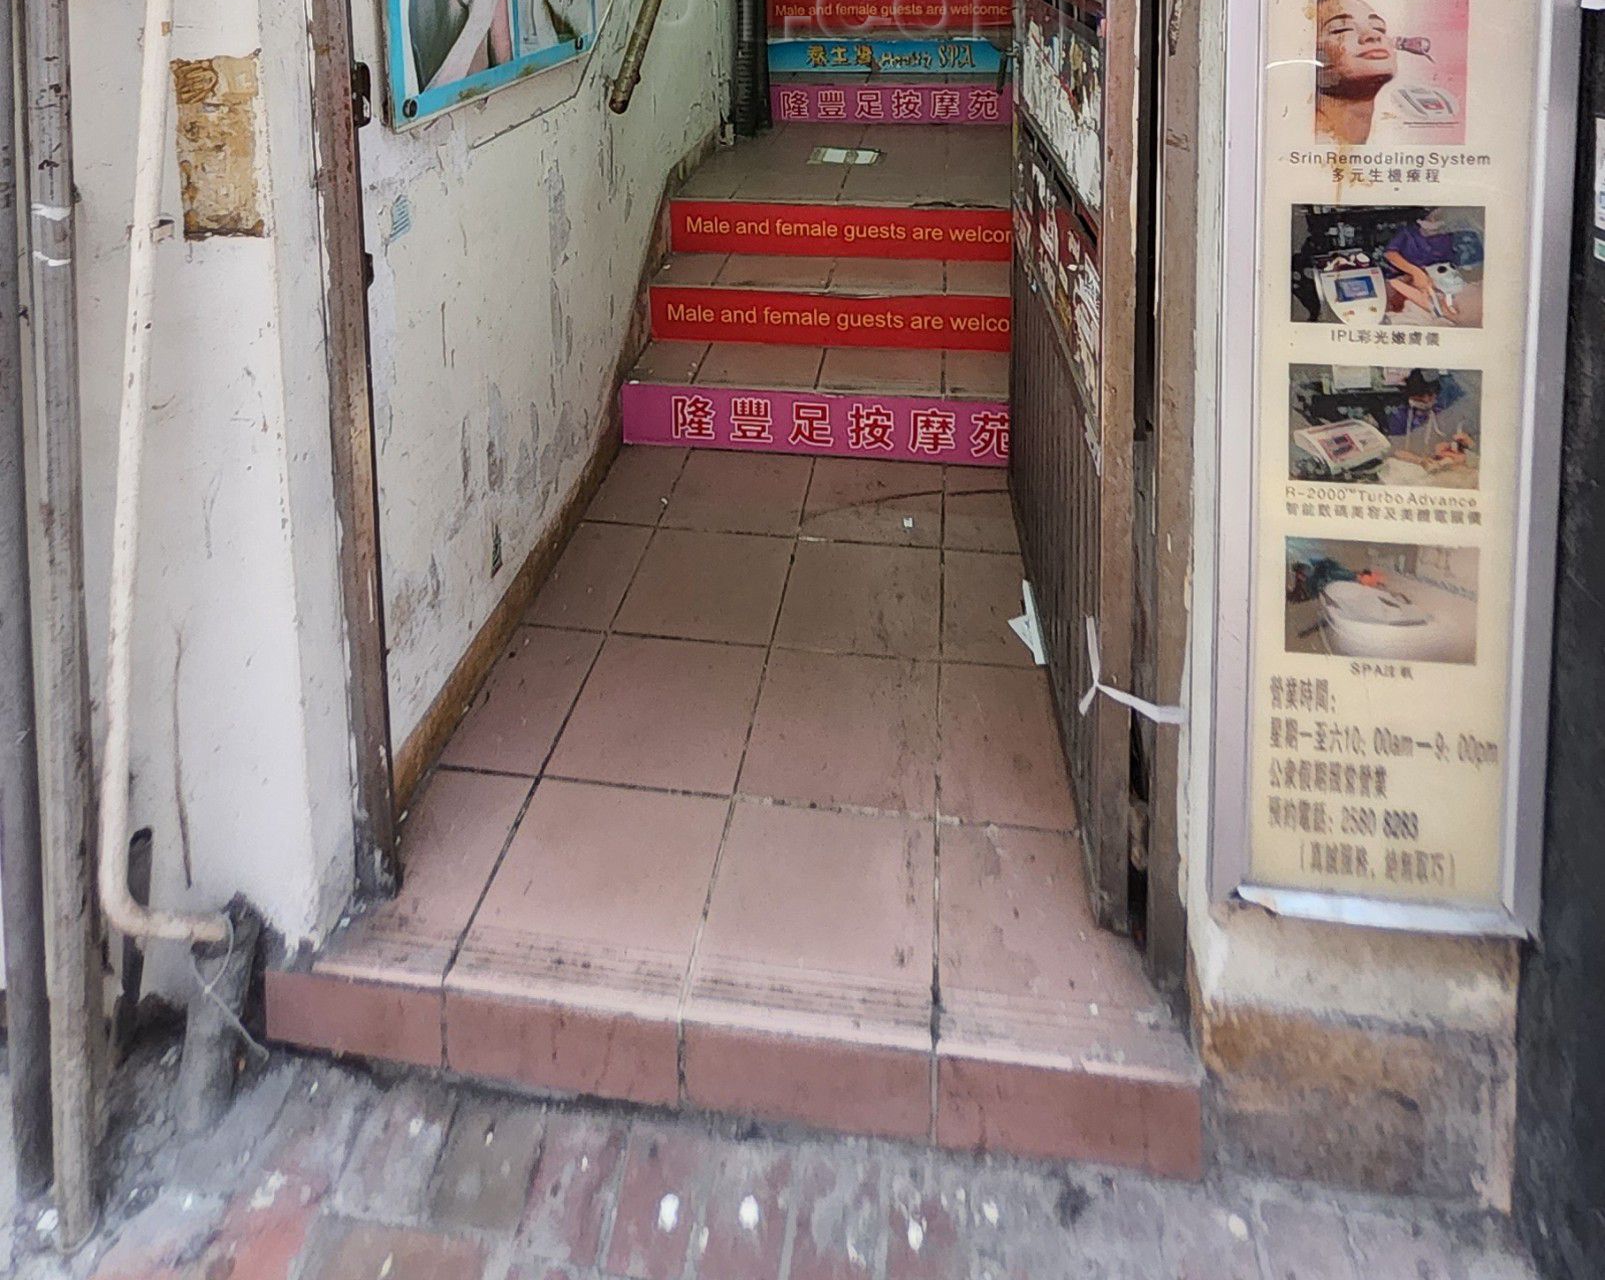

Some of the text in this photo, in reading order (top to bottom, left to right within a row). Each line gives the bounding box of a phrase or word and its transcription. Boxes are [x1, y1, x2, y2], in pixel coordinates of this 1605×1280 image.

[776, 4, 1008, 18] Male and female guests are welcome
[781, 90, 999, 120] 隆豐足按摩苑
[1326, 152, 1424, 167] Remodeling
[1428, 152, 1490, 168] System
[686, 217, 730, 234] Male
[736, 218, 770, 235] and
[776, 219, 838, 238] female
[844, 222, 906, 242] guests
[912, 227, 944, 242] are
[667, 304, 714, 323] Male
[720, 306, 757, 324] and
[764, 307, 830, 327] female
[836, 313, 904, 332] guests
[911, 316, 944, 331] are
[671, 395, 1010, 459] 隆豐足按摩苑
[1359, 490, 1406, 505] Turbo
